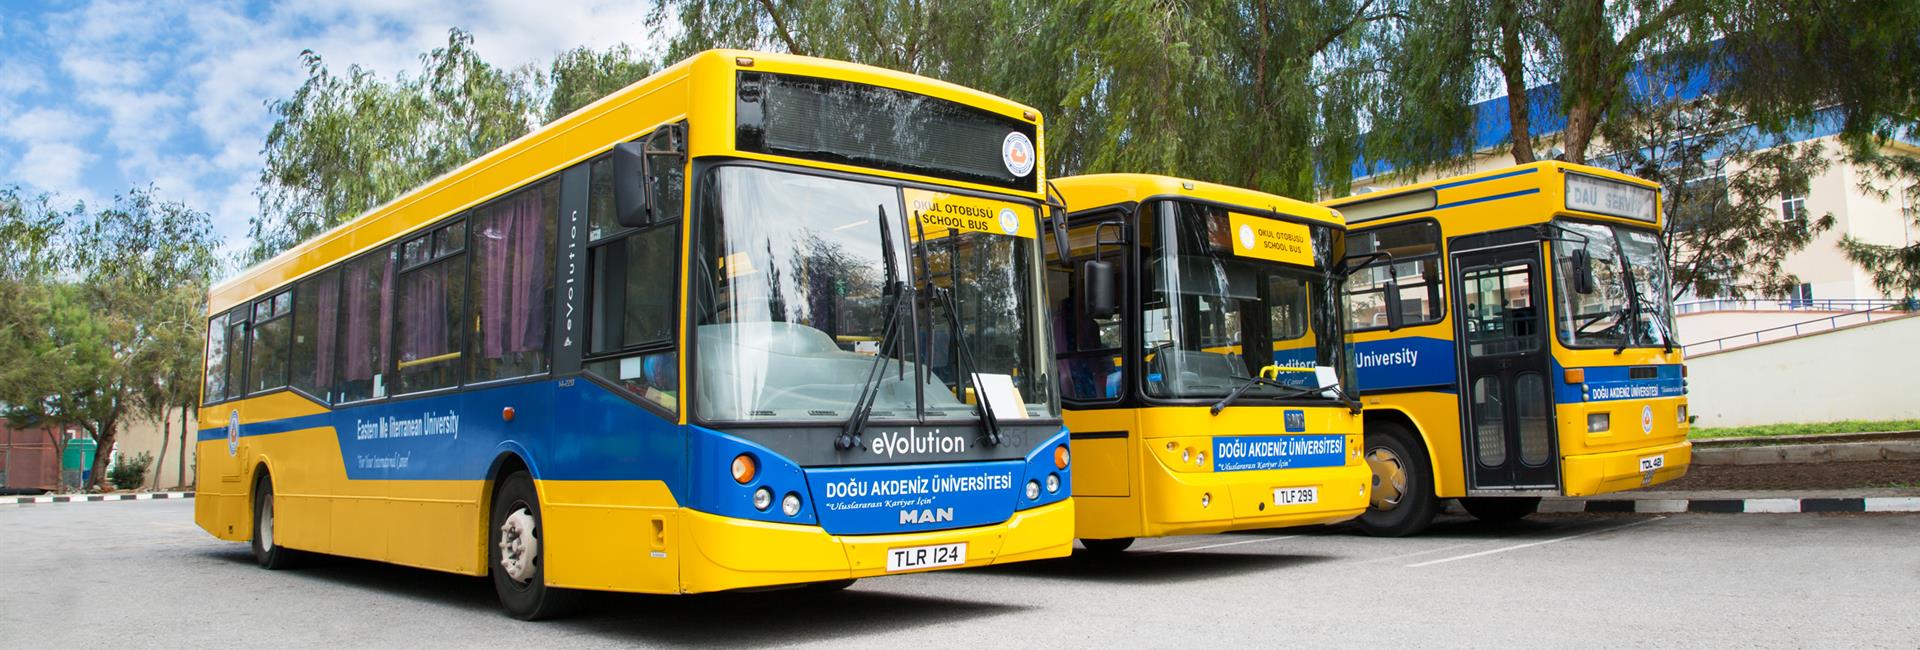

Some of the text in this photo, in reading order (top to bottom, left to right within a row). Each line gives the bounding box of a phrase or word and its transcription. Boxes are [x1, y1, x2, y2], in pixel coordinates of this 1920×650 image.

[913, 199, 993, 219] OKUL OTOBÜSÜ
[922, 214, 965, 228] SCHOOL
[968, 221, 988, 231] BUS
[1258, 228, 1275, 238] OKUL
[1264, 240, 1302, 254] SCHOOL BUS
[1355, 348, 1418, 367] University
[357, 419, 378, 440] Eastern
[424, 409, 459, 439] University
[872, 427, 965, 459] eVolution
[1218, 436, 1343, 458] DOĞU AKDENİZ ÜNİVERSİTESİ
[826, 472, 1012, 498] DOĞU AKDENİZ ÜNİVERSİTESİ
[884, 499, 915, 508] Kariyer
[1281, 489, 1313, 504] TLF 299
[899, 507, 954, 525] MAN
[894, 546, 958, 568] TLR 124
